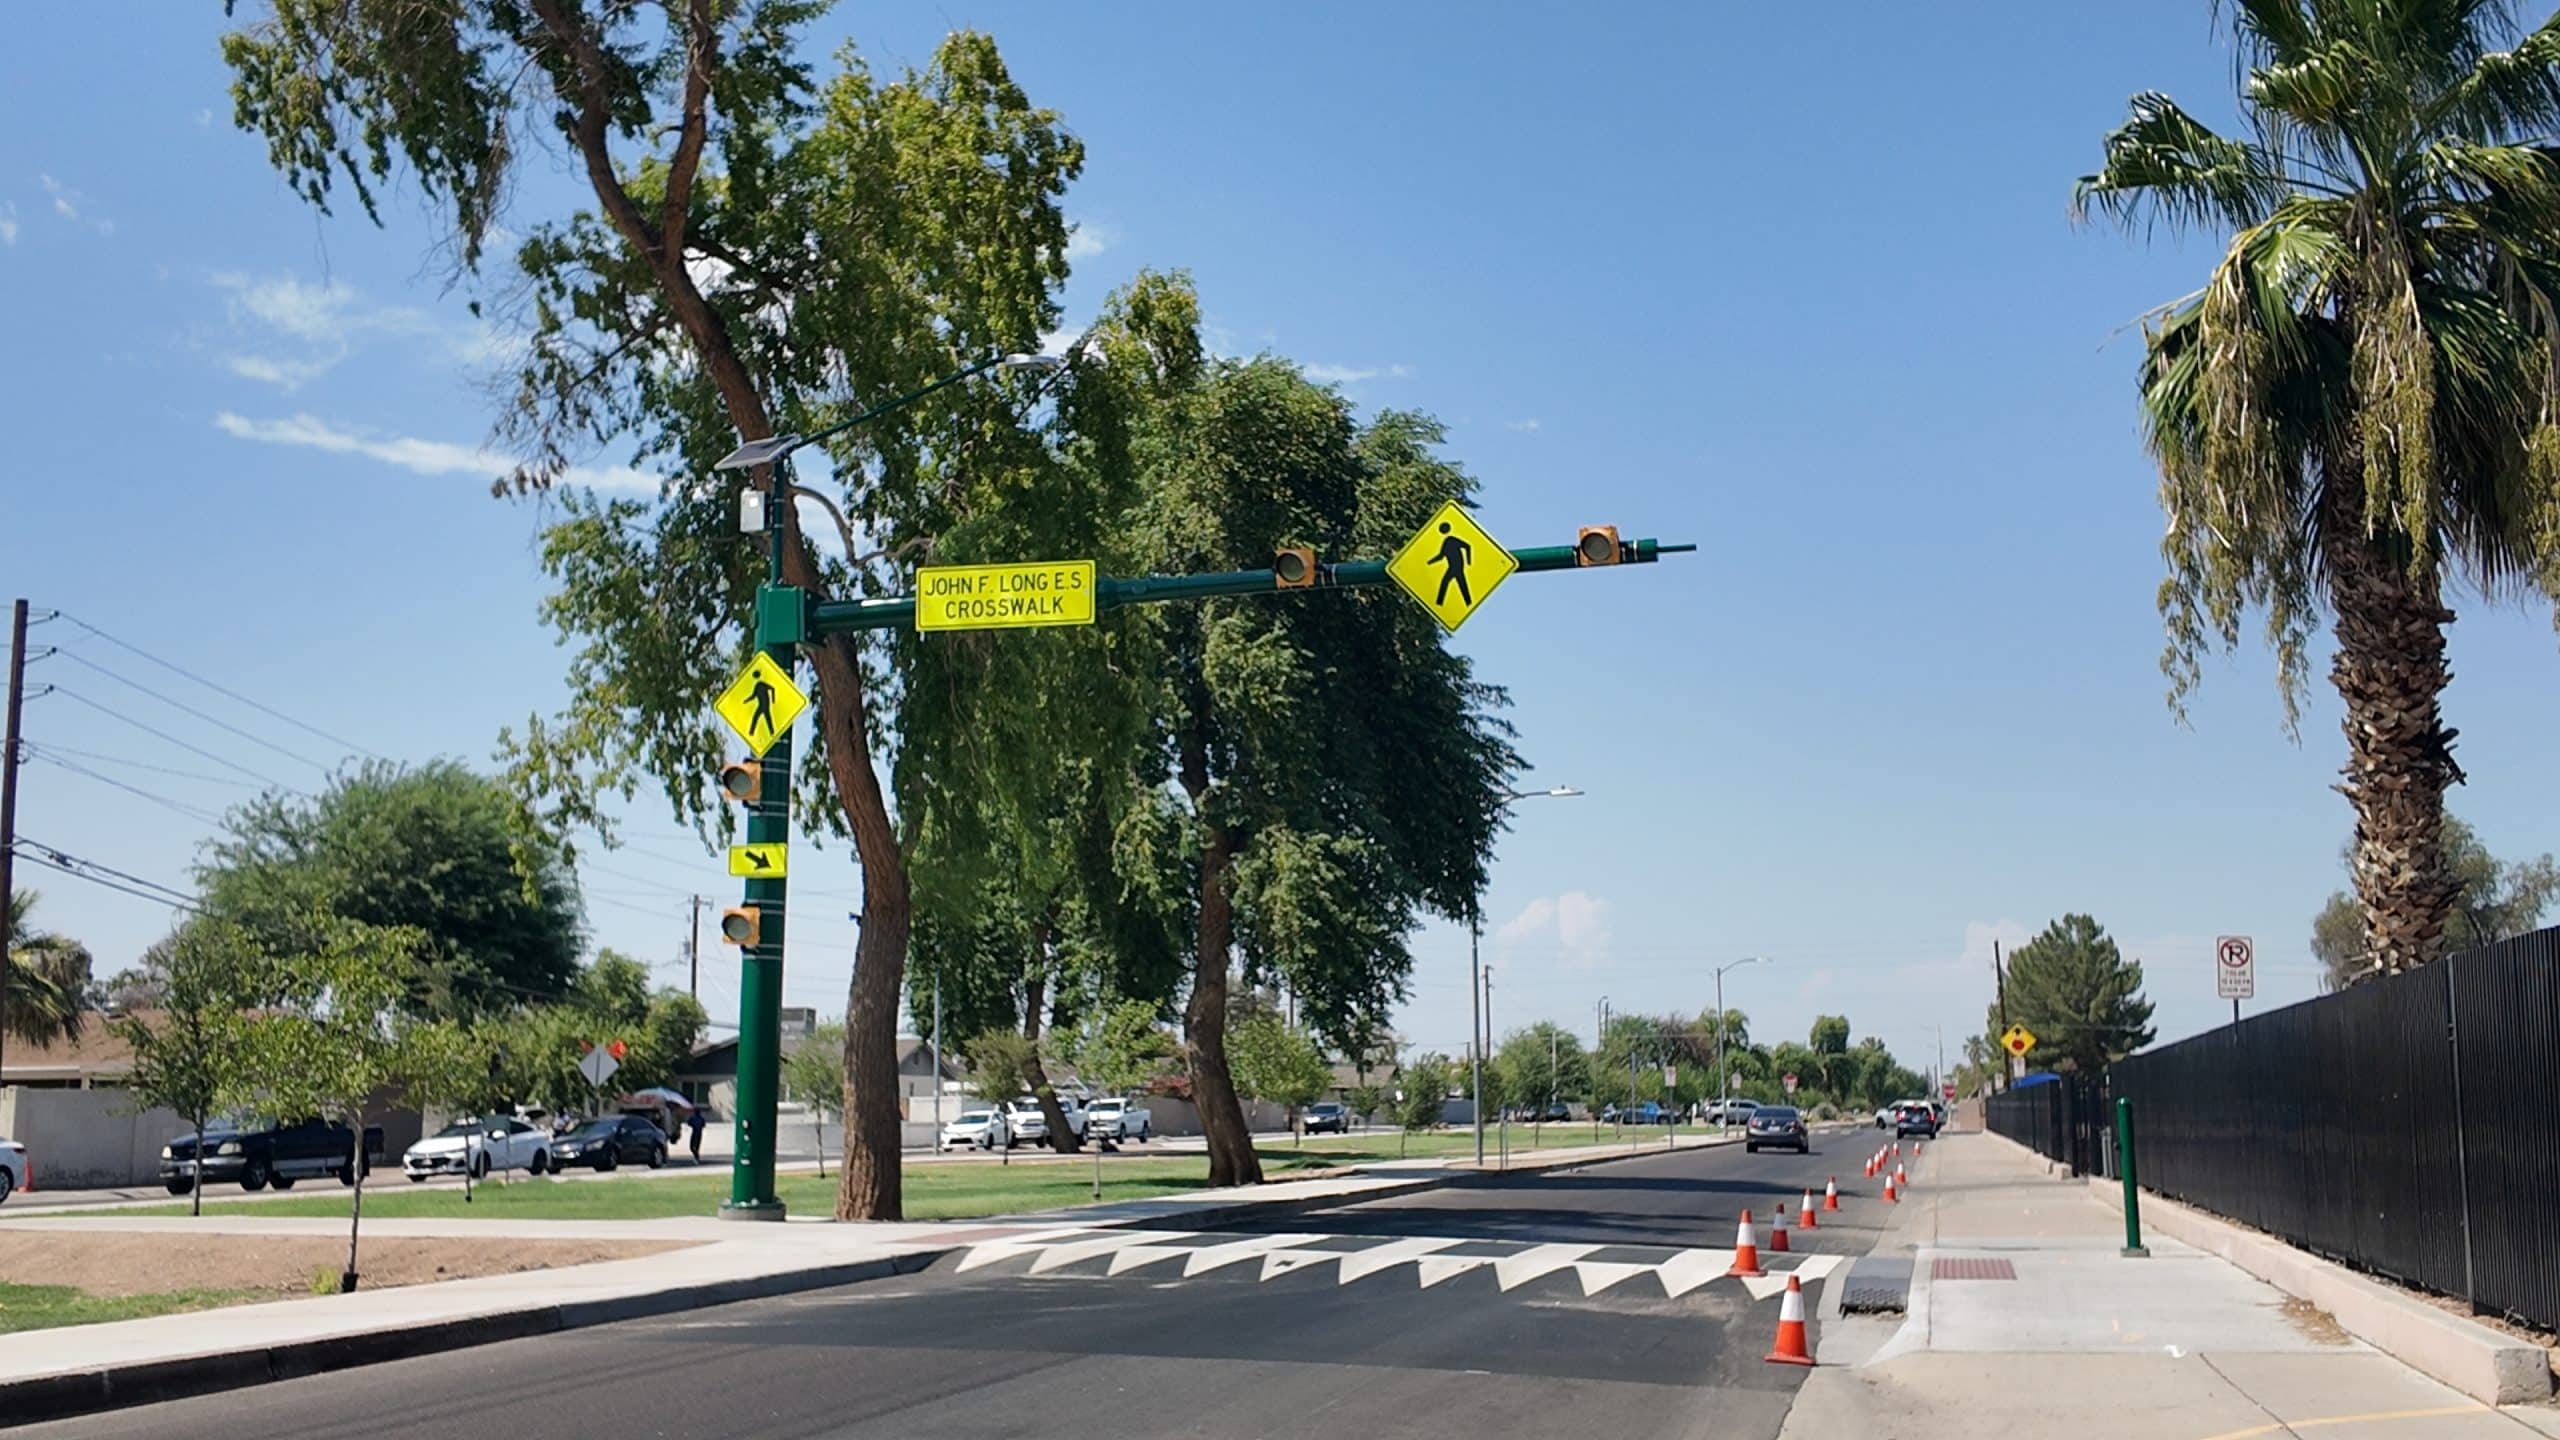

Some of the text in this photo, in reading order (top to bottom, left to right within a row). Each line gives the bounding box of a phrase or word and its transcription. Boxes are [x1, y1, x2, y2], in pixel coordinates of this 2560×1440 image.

[925, 576, 973, 596] JOHN
[1000, 572, 1049, 593] LONG
[945, 596, 1064, 618] CROSSWALK
